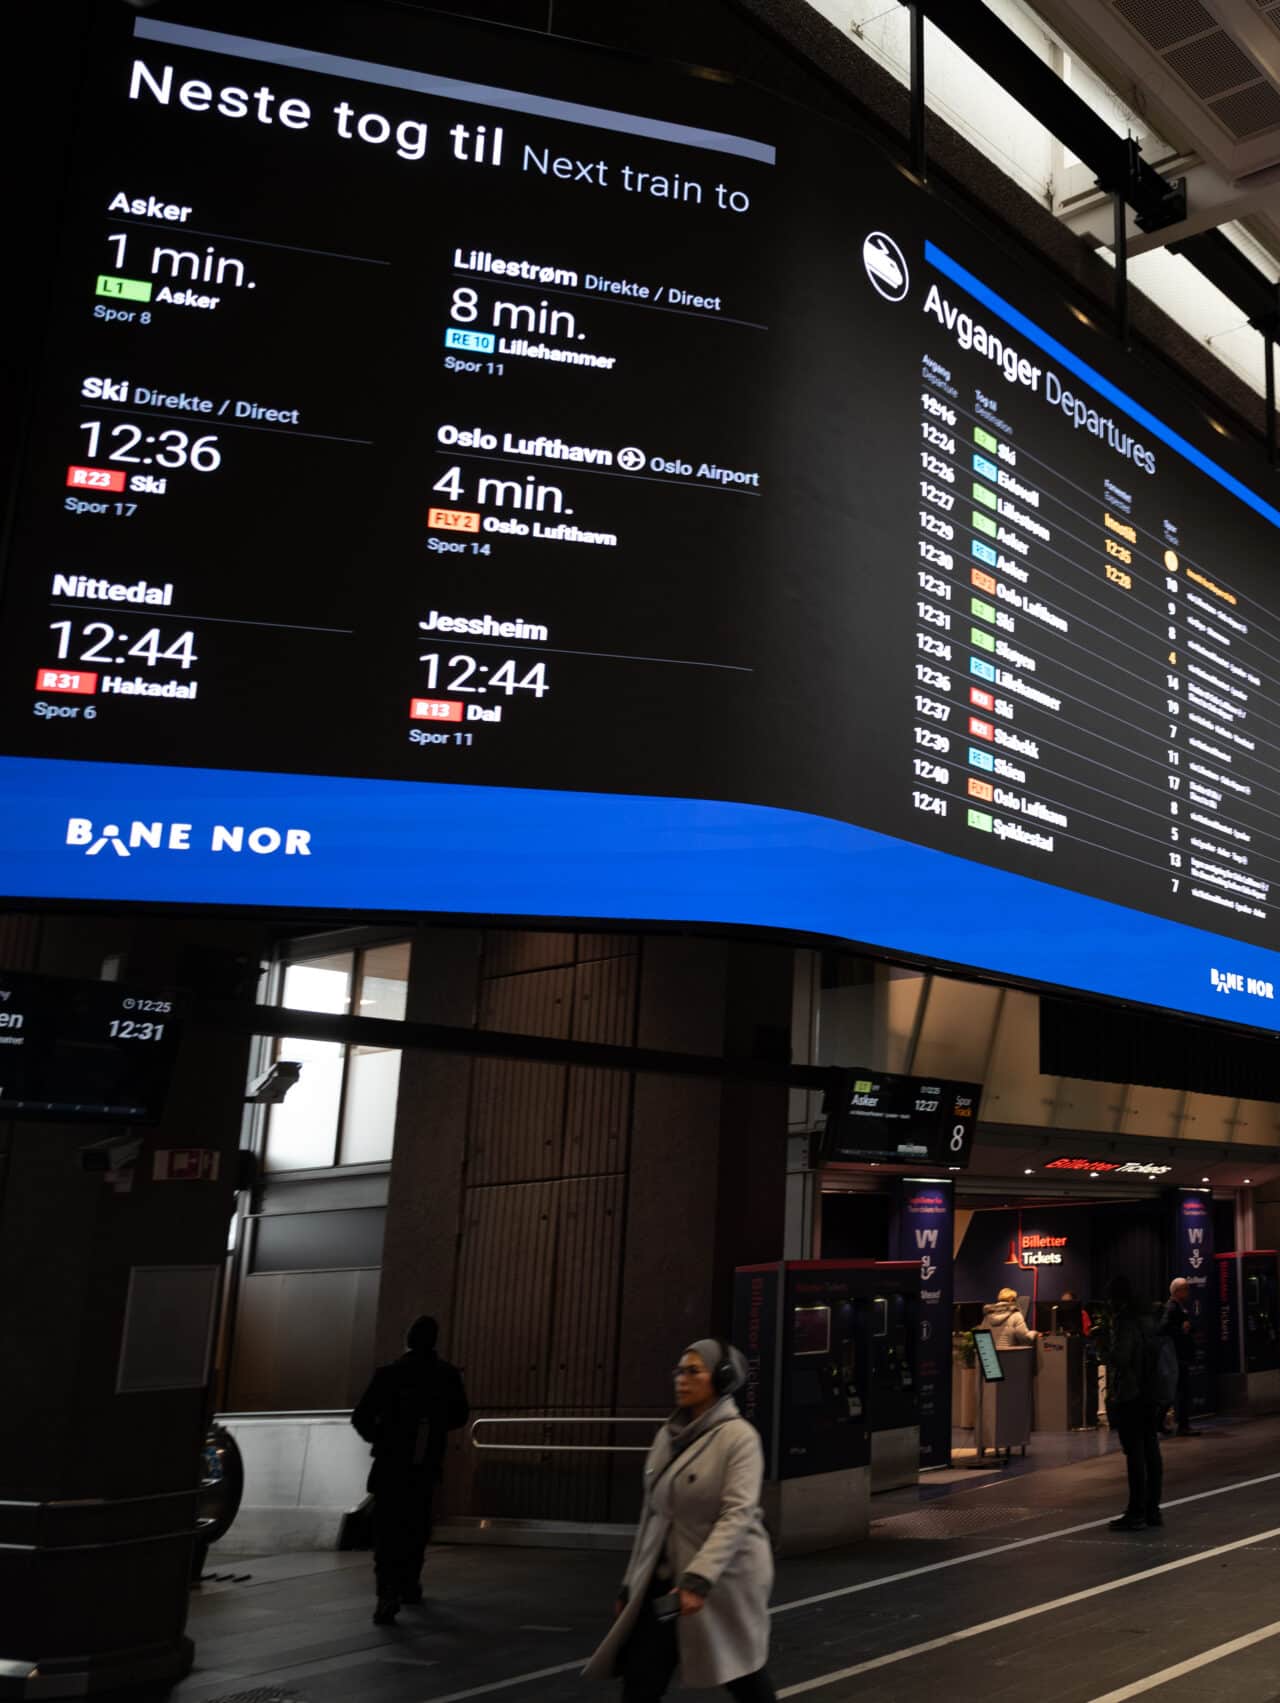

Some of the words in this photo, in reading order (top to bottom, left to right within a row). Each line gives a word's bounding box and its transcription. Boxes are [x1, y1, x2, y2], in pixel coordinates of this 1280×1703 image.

[130, 60, 310, 128] Neste
[334, 102, 427, 160] tog
[450, 124, 503, 165] til
[524, 145, 608, 186] Next
[622, 166, 701, 203] train
[716, 184, 749, 211] to
[108, 193, 192, 222] Asker
[109, 234, 126, 268] 1
[152, 242, 257, 290] min.
[454, 249, 577, 286] Lillestrøm
[585, 274, 649, 298] Direkte
[669, 288, 720, 310] Direct
[156, 287, 220, 309] Asker
[94, 305, 136, 322] Spor
[140, 312, 151, 324] 8
[451, 288, 477, 322] 8
[493, 301, 585, 339] min.
[444, 356, 482, 372] Spor
[486, 362, 503, 376] 11
[498, 335, 616, 370] Lillehammer
[923, 285, 1041, 391] Avganger
[1047, 372, 1155, 474] Departures
[82, 378, 128, 401] Ski
[134, 388, 213, 412] Direkte
[235, 401, 299, 424] Direct
[80, 422, 220, 471] 12:36
[921, 423, 955, 454] 12:24
[438, 425, 497, 449] Oslo
[503, 433, 612, 465] Lufthavn
[650, 457, 692, 475] Oslo
[696, 464, 759, 486] Airport
[920, 452, 955, 483] 12:26
[73, 468, 111, 488] R23
[130, 476, 166, 494] Ski
[433, 467, 464, 500] 4
[478, 476, 573, 514] min.
[64, 497, 109, 514] Spor
[114, 503, 137, 516] 17
[920, 481, 954, 511] 12:27
[434, 511, 461, 529] FLY
[483, 517, 529, 535] Oslo
[533, 523, 616, 545] Lufthavn
[427, 537, 464, 555] Spor
[471, 543, 491, 556] 14
[918, 541, 953, 570] 12:30
[52, 574, 173, 605] Nittedal
[918, 572, 951, 600] 12:31
[919, 512, 954, 540] 12:29
[1169, 652, 1176, 664] 4
[419, 611, 548, 640] Jessheim
[50, 621, 197, 668] 12:44
[916, 633, 952, 661] 12:34
[420, 654, 549, 697] 12:44
[915, 664, 951, 691] 12:36
[917, 602, 950, 630] 12:31
[1170, 725, 1177, 738] 7
[42, 672, 82, 690] R31
[102, 676, 197, 699] Hakadal
[33, 702, 80, 719] Spor
[84, 706, 96, 719] 6
[415, 702, 450, 719] R13
[467, 705, 501, 722] Dal
[915, 696, 950, 721] 12:37
[409, 729, 450, 745] Spor
[454, 732, 472, 745] 11
[913, 759, 949, 784] 12:40
[914, 727, 950, 753] 12:39
[1171, 827, 1178, 840] 5
[66, 818, 192, 857] BANE
[211, 825, 312, 856] NOR
[912, 792, 947, 816] 12:41
[1172, 879, 1179, 892] 7
[1247, 977, 1274, 999] NOR
[138, 1000, 171, 1012] 12:25
[110, 1020, 163, 1040] 12:31
[851, 1094, 879, 1107] Asker
[914, 1100, 939, 1112] 12:27
[950, 1125, 964, 1151] 8
[1043, 1157, 1121, 1173] Billetter
[1115, 1161, 1172, 1175] Tickets
[1023, 1234, 1067, 1249] Billetter
[1022, 1251, 1062, 1265] Tickets
